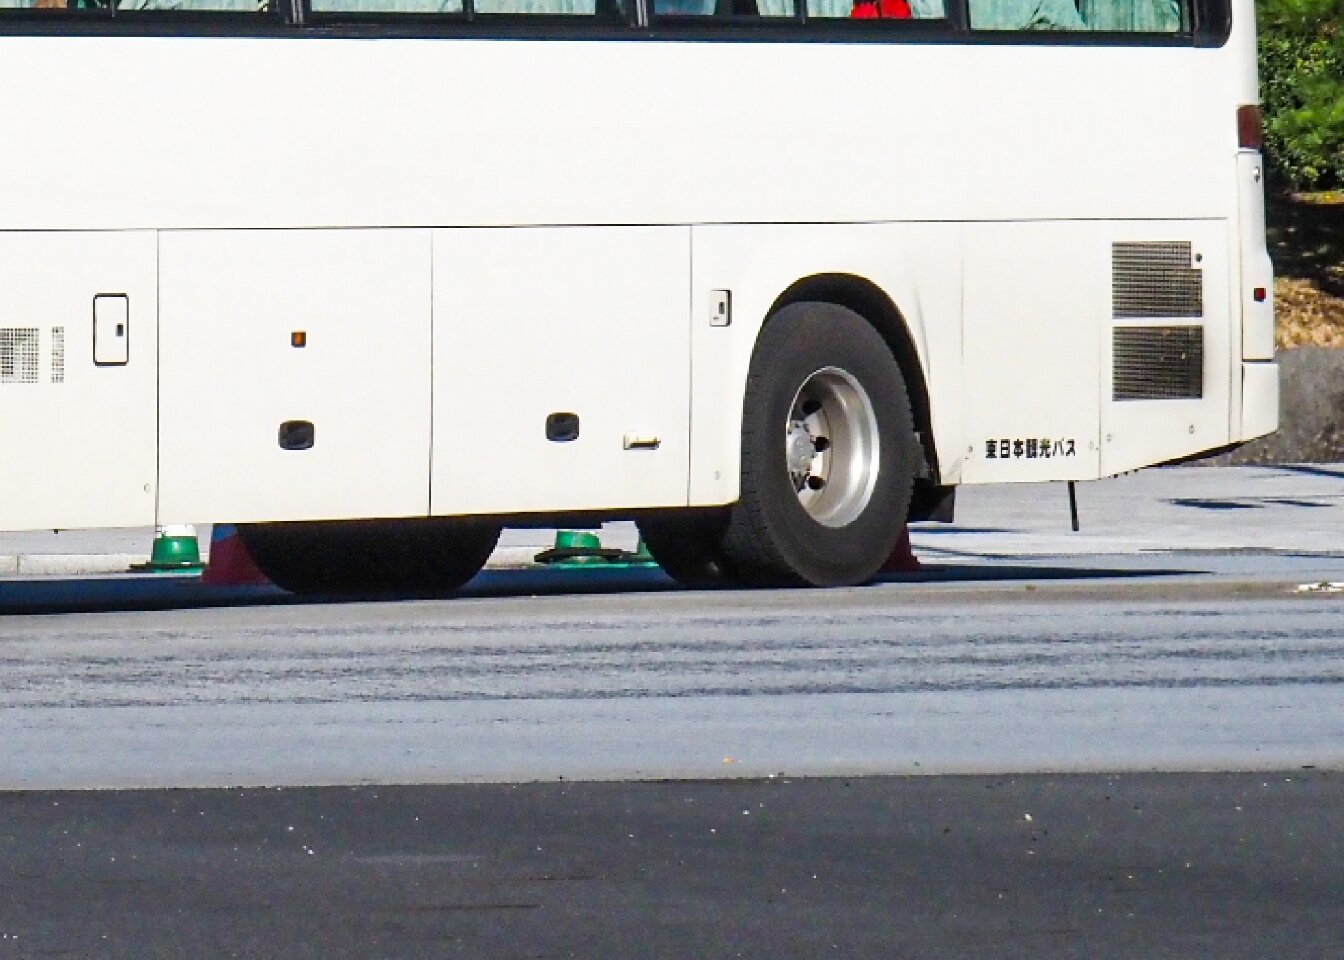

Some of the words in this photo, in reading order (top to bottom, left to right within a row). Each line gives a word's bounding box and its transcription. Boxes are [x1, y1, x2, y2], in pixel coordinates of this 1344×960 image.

[985, 437, 1076, 458] 東日本観光バス
